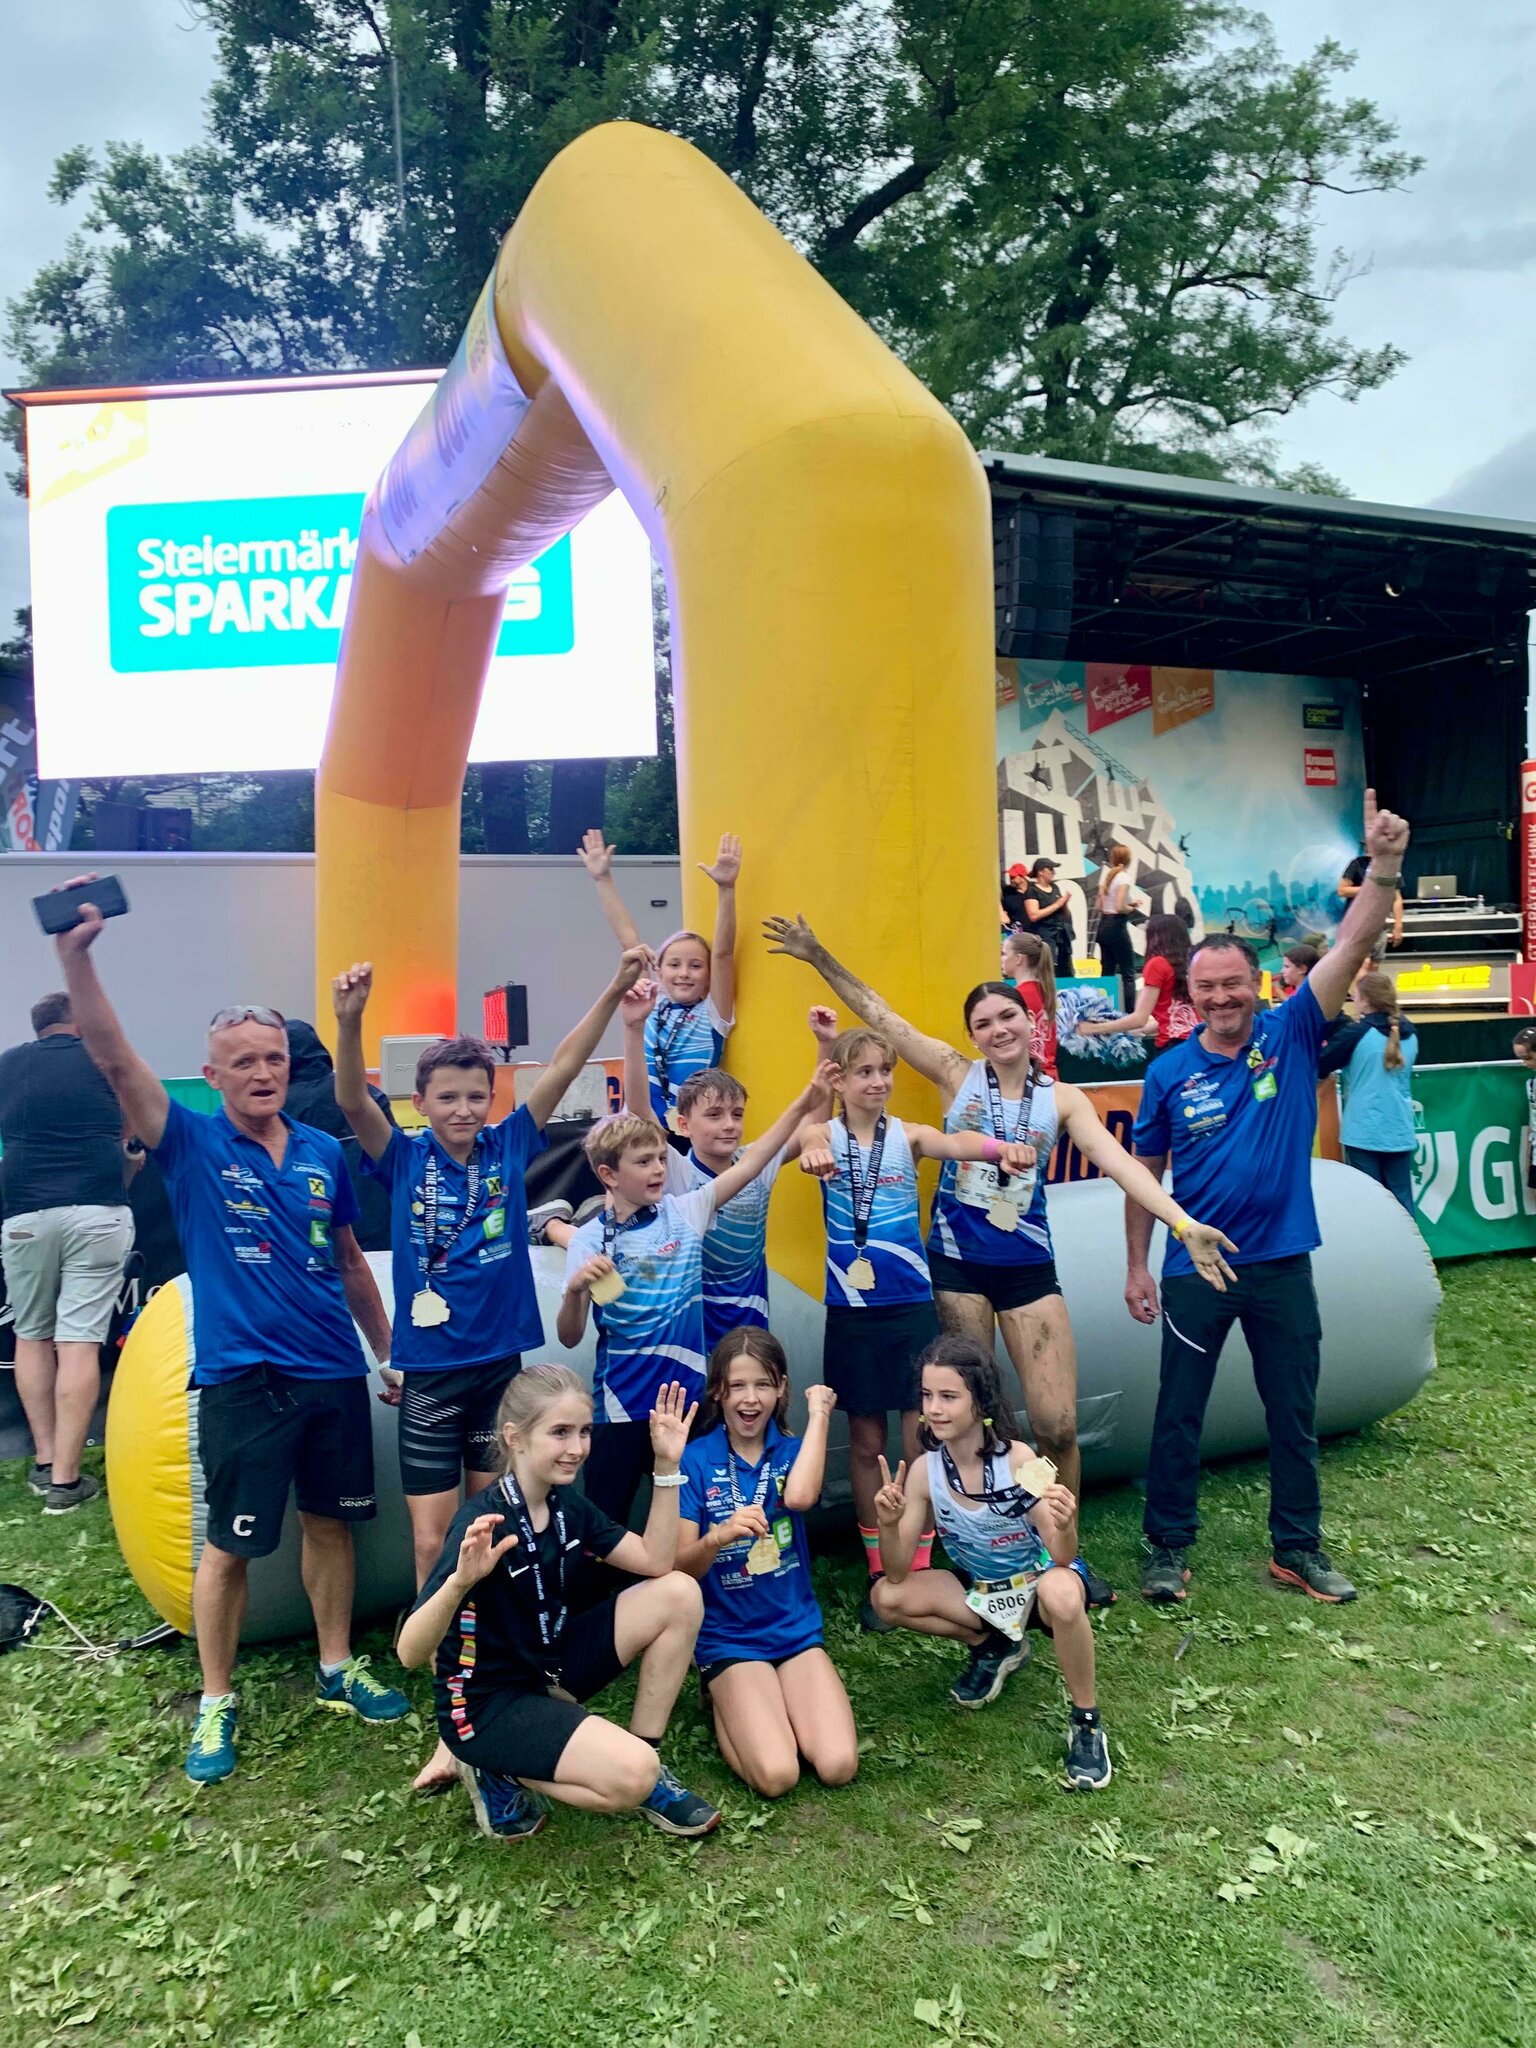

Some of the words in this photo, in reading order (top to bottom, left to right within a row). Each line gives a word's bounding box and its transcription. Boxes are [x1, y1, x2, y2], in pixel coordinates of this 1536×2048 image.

[980, 1168, 998, 1183] 78
[425, 1186, 437, 1206] CITY
[988, 1593, 1026, 1614] 6806
